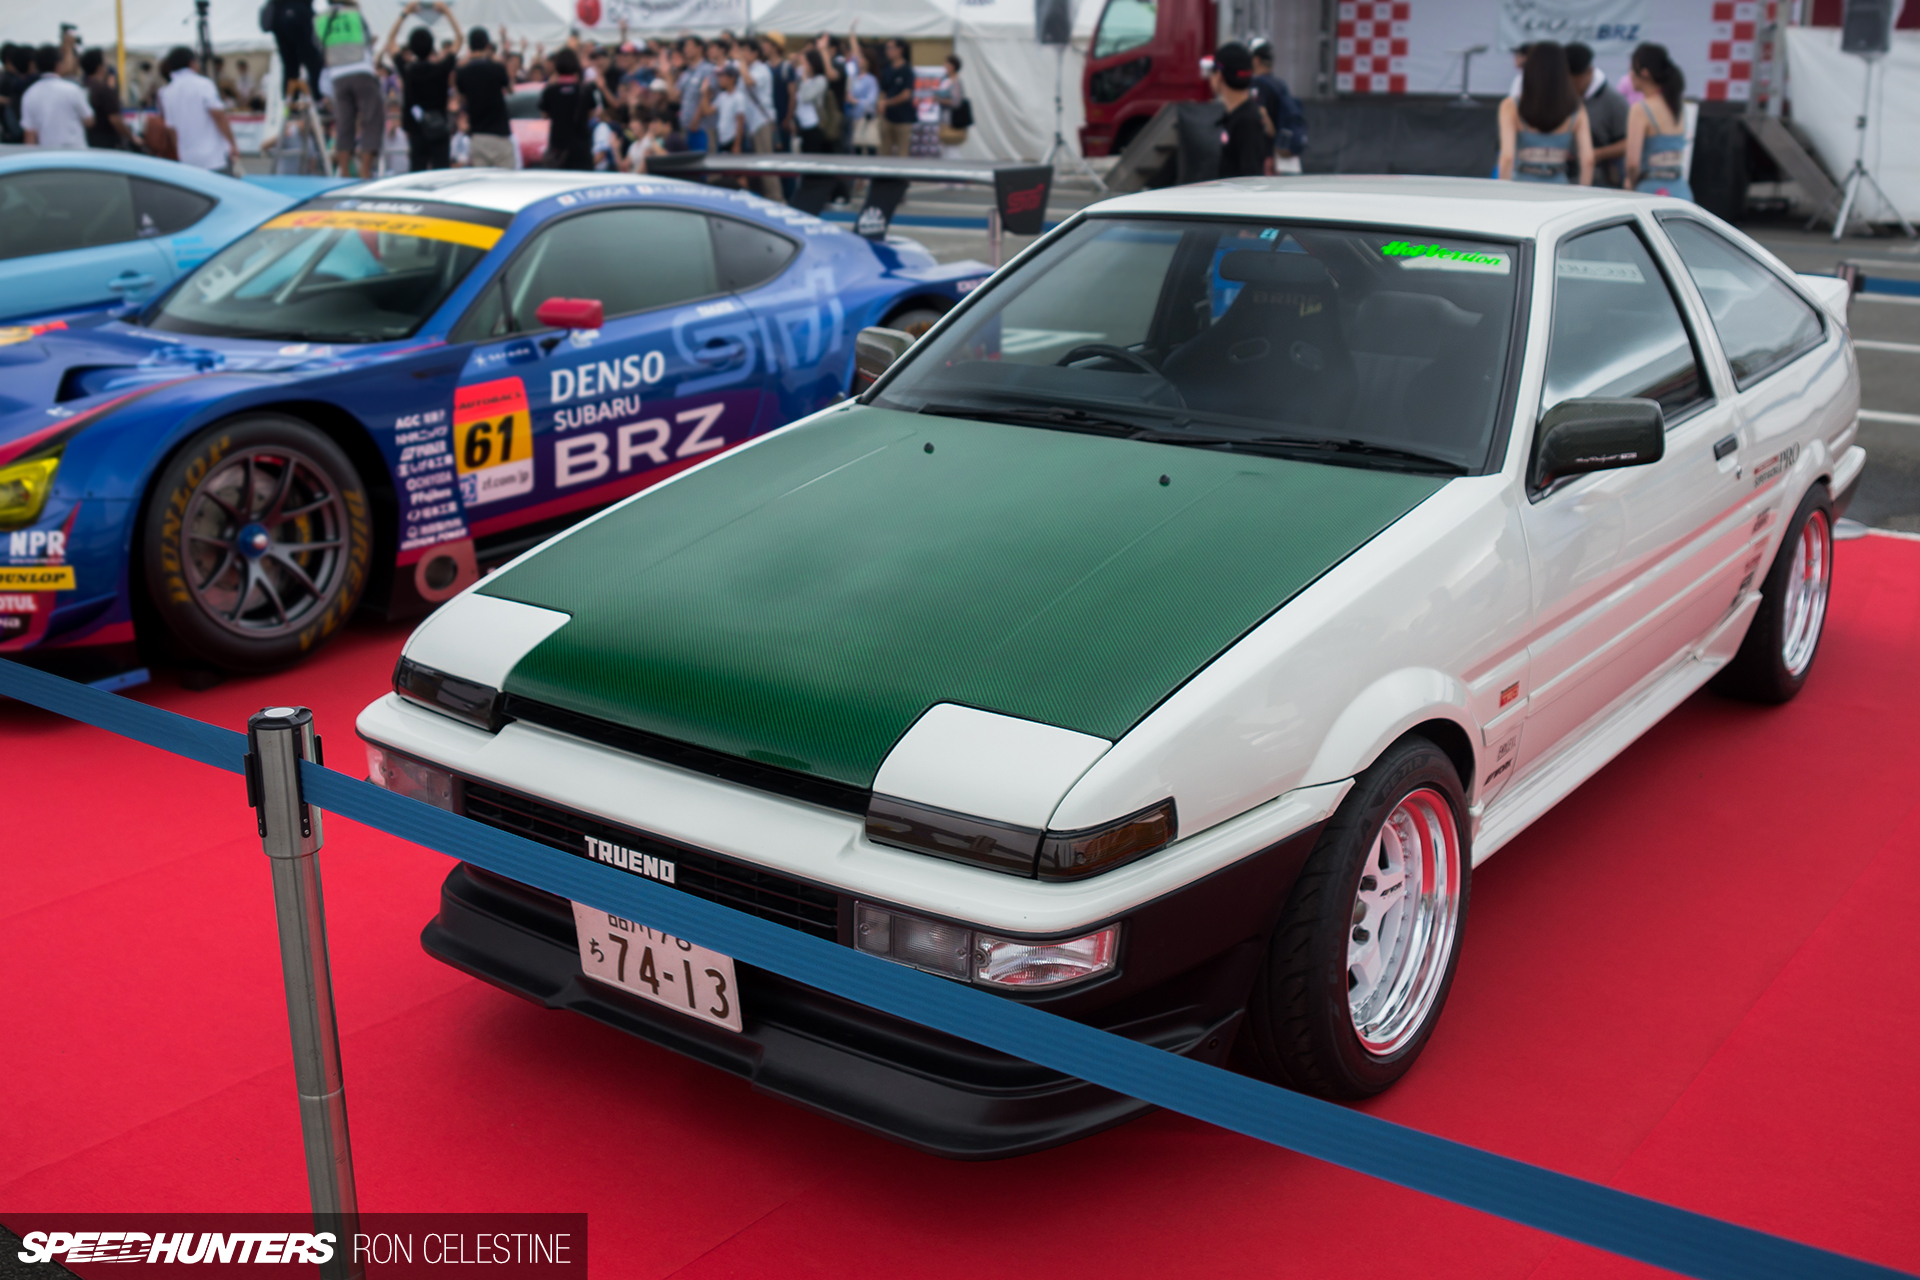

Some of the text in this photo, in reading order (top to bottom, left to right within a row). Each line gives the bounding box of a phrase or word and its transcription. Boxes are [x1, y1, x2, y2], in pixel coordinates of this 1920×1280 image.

[551, 350, 665, 404] DENSO
[554, 394, 640, 432] SUBARU
[463, 414, 515, 469] 61
[555, 402, 725, 488] BRZ
[1779, 441, 1800, 474] PRO
[10, 530, 66, 557] NPR
[584, 835, 675, 884] TRUENO
[588, 932, 730, 1019] ち 74-13
